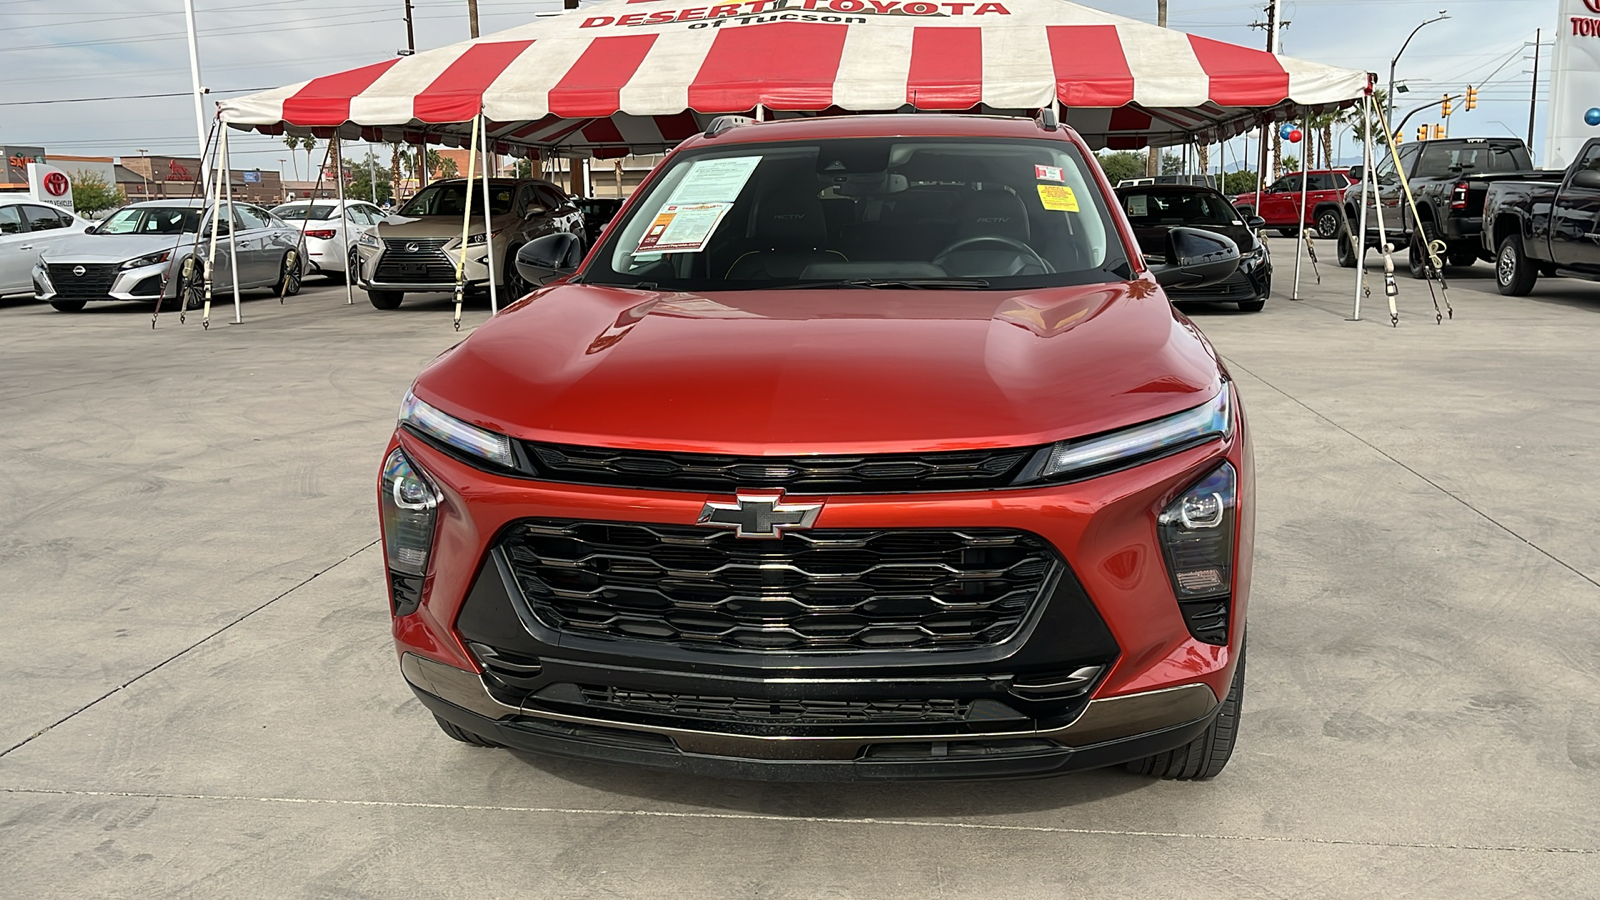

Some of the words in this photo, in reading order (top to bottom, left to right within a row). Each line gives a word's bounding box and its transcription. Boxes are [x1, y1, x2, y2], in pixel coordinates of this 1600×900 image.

[579, 0, 775, 28] DESERT
[688, 19, 728, 29] of
[734, 14, 866, 25] Tucson
